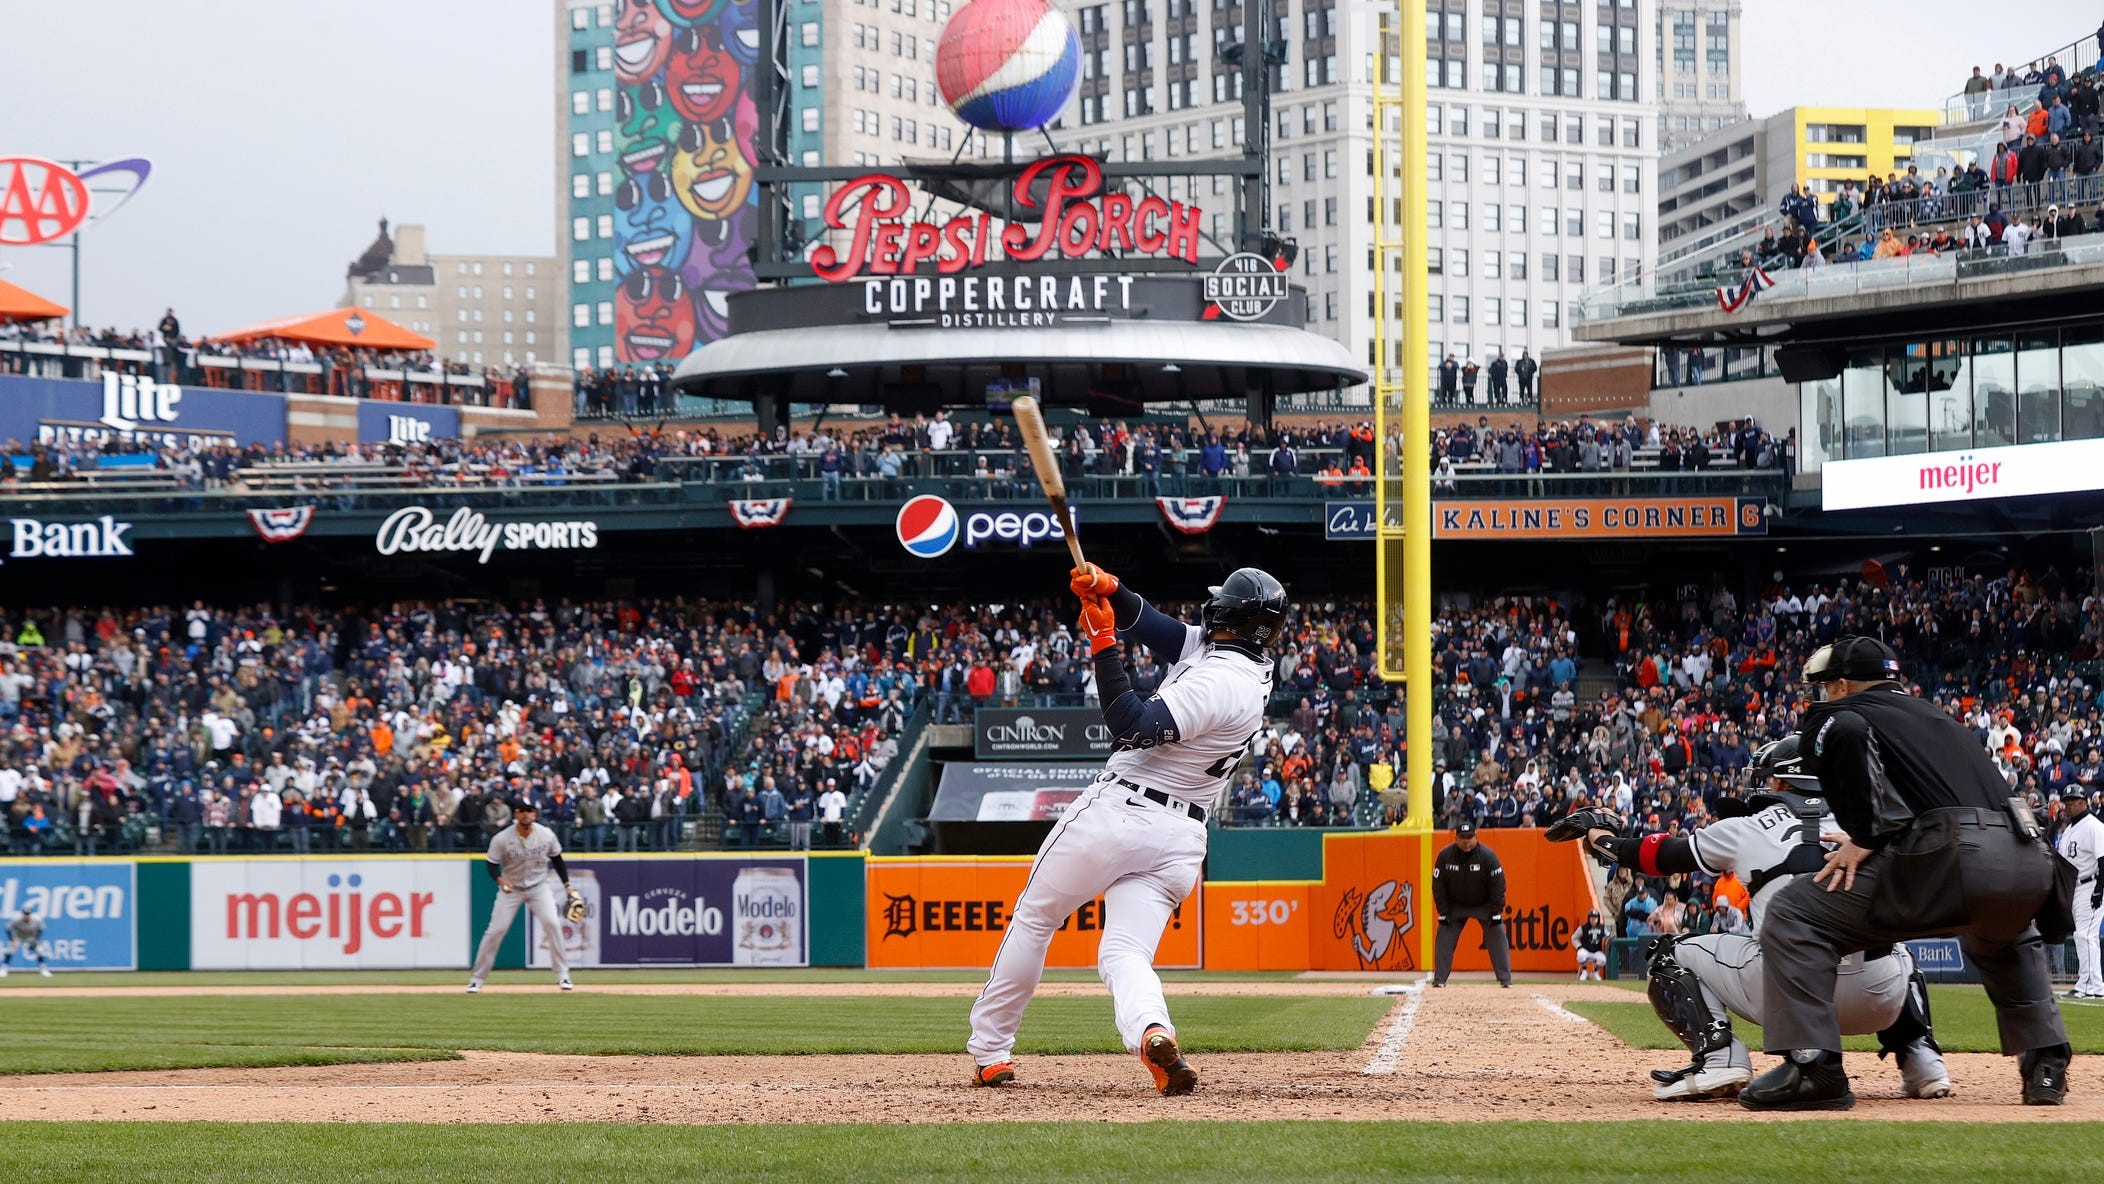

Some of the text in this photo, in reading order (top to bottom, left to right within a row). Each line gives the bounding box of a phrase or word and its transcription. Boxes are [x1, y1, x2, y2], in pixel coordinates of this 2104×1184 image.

[811, 154, 1202, 283] PEPSI PORCH
[1234, 258, 1258, 272] 416
[865, 275, 1134, 314] COPPERCRAFT
[1208, 277, 1285, 296] SOCIAL
[941, 312, 1056, 328] DISTILLERY
[1231, 300, 1262, 315] CLUB
[100, 366, 182, 432] Lite
[388, 415, 431, 447] Lite
[1919, 454, 2002, 494] meijer
[1442, 504, 1760, 529] KALINE'S CORNER 6
[9, 515, 135, 557] Bank
[376, 506, 598, 564] Bally SPORTS
[986, 723, 1064, 742] CINTRON
[1163, 729, 1174, 741] 28
[973, 767, 1040, 775] OFFICIAL
[1788, 765, 1801, 774] 24
[0, 878, 124, 919] Laren
[644, 887, 687, 900] CERVEZA
[738, 894, 796, 918] Modelo
[226, 874, 433, 955] meijer
[610, 895, 724, 936] Modelo
[1479, 904, 1569, 951] ittle
[1918, 945, 1954, 962] Bank
